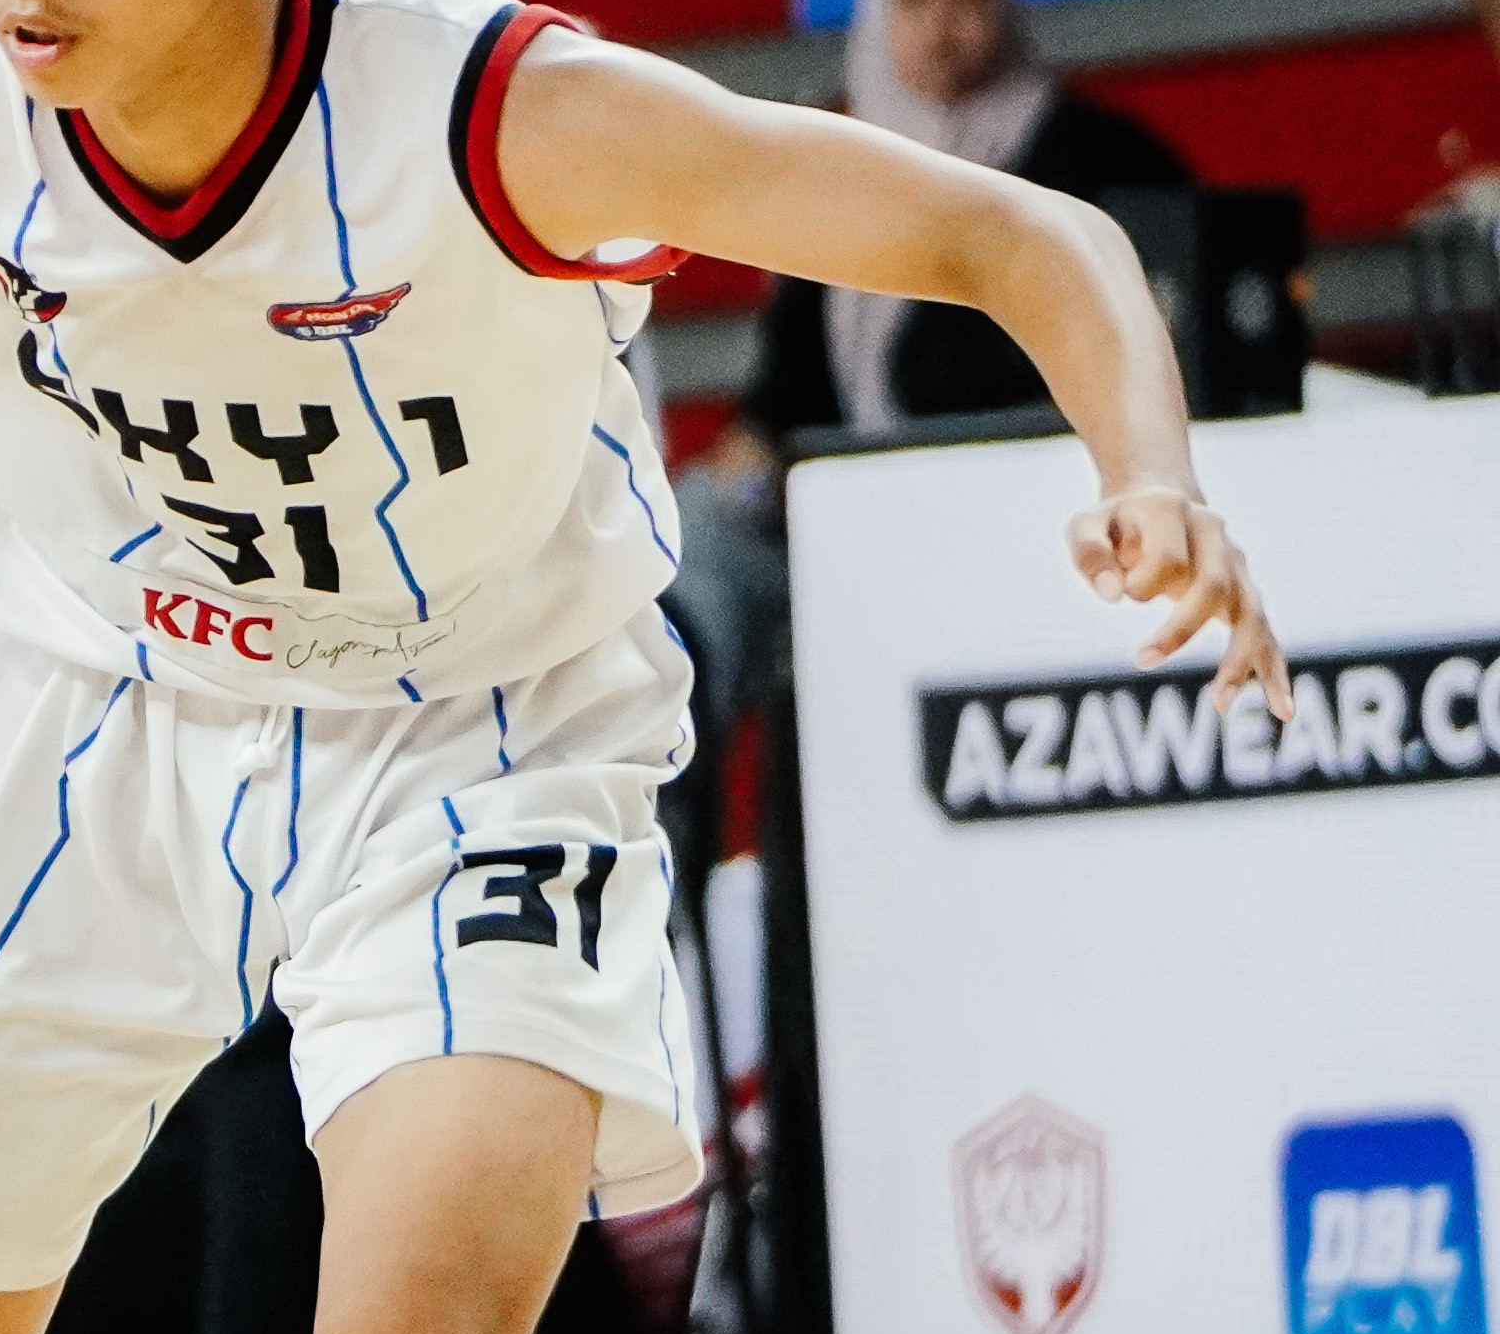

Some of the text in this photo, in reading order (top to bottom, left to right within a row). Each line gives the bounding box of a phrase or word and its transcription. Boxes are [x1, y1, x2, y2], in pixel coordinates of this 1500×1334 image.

[160, 492, 340, 594] 31
[142, 587, 274, 662] KFC
[456, 840, 618, 974] 31
